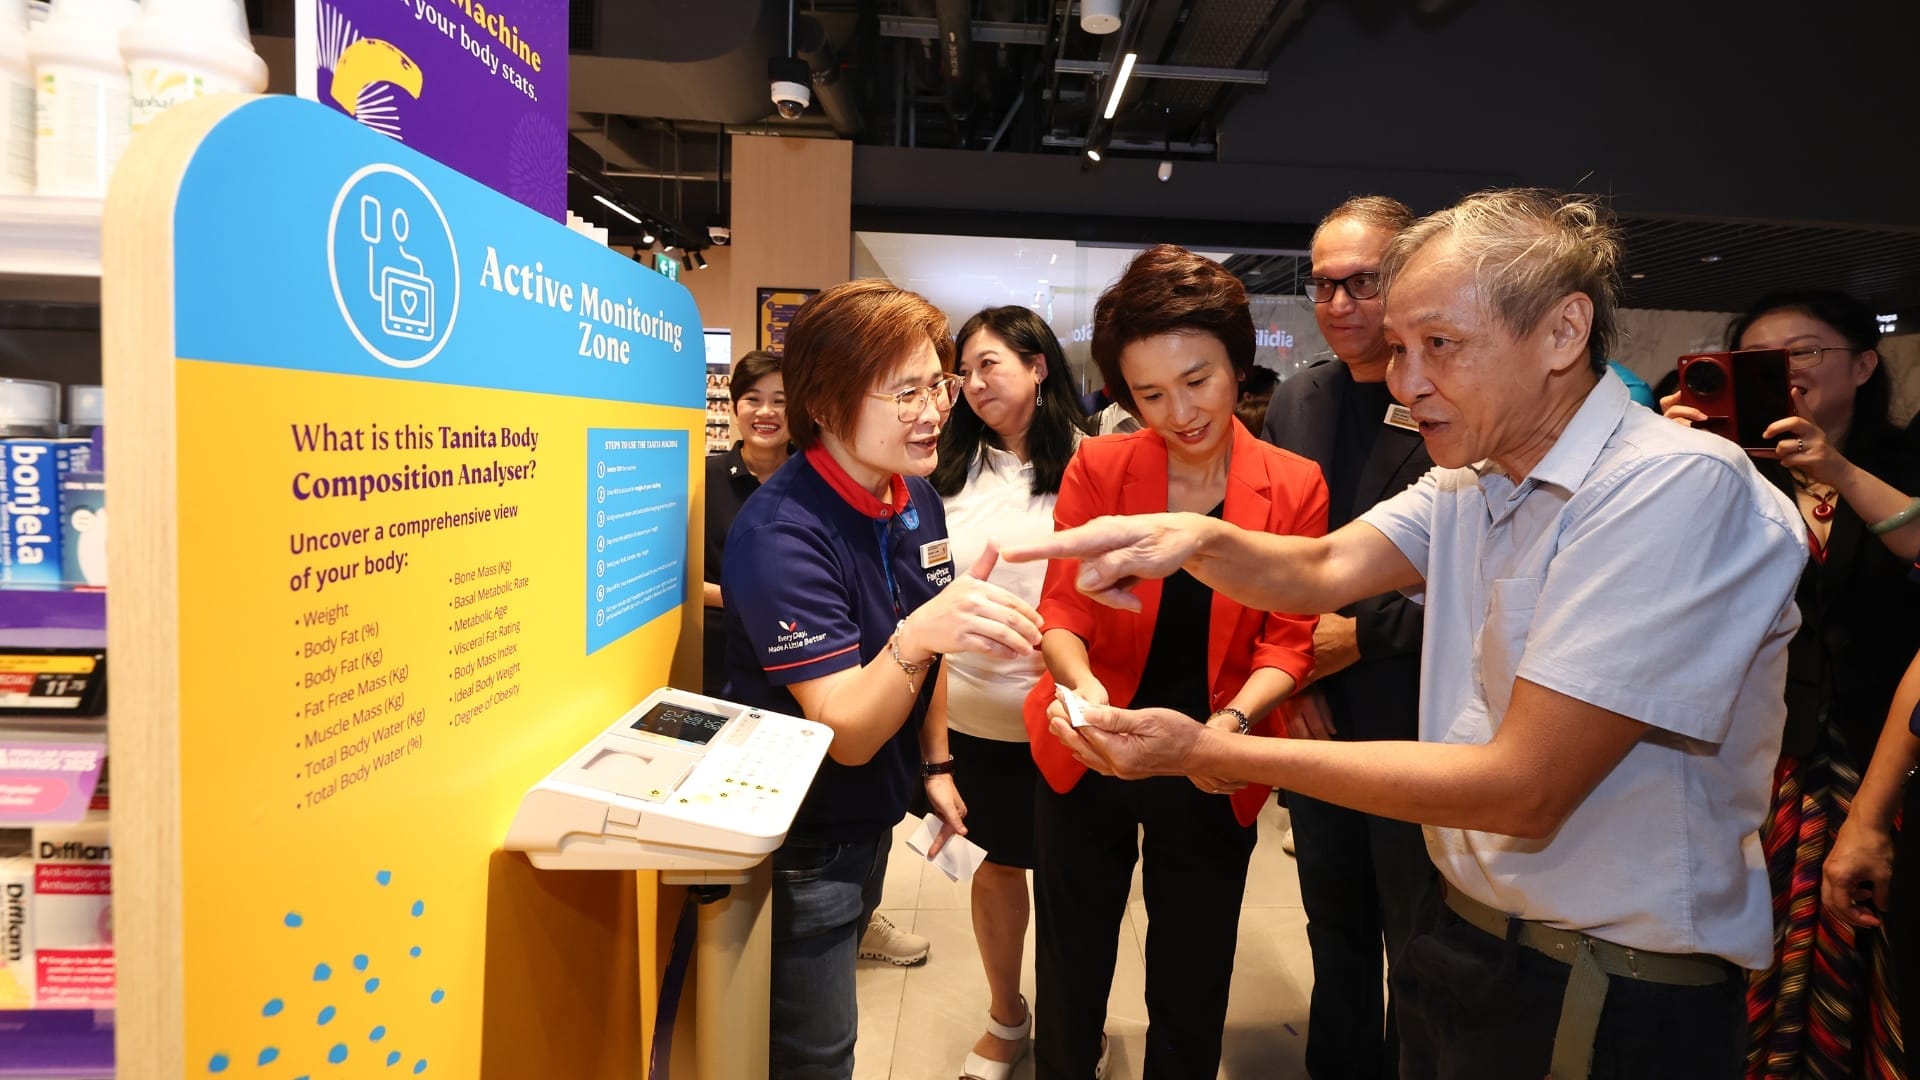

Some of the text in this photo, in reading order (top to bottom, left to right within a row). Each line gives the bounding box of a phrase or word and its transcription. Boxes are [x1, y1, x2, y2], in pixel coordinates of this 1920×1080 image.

[415, 0, 538, 102] your body stats.
[480, 246, 683, 353] Active Monitoring
[578, 321, 630, 365] Zone
[291, 422, 539, 452] What is this Tanita Body
[292, 459, 537, 501] Composition Analyser?
[7, 446, 51, 565] bonjela
[290, 503, 518, 555] Uncover a comprehensive view
[290, 550, 409, 592] of your body:
[454, 560, 512, 585] Bone Mass (Kg)
[454, 576, 528, 609] Basal Metabolic Rate
[304, 604, 349, 627] Weight
[454, 605, 508, 632] Metabolic Age
[778, 630, 808, 642] Every Day,
[304, 621, 379, 658] Body Fat (%)
[454, 621, 520, 656] Visceral Fat Rating
[804, 633, 826, 646] Better
[304, 648, 382, 688] Body Fat (Kg)
[454, 644, 517, 680] Body Mass Index
[454, 662, 520, 703] Ideal Body Weight
[304, 665, 408, 719] Fat Free Mass (Kg)
[454, 684, 520, 727] Degree of Obesity
[304, 692, 404, 749] Muscle Mass (Kg)
[304, 708, 425, 778] Total Body Water (Kg)
[305, 734, 422, 808] Total Body Water (%)
[7, 883, 24, 961] Difflam
